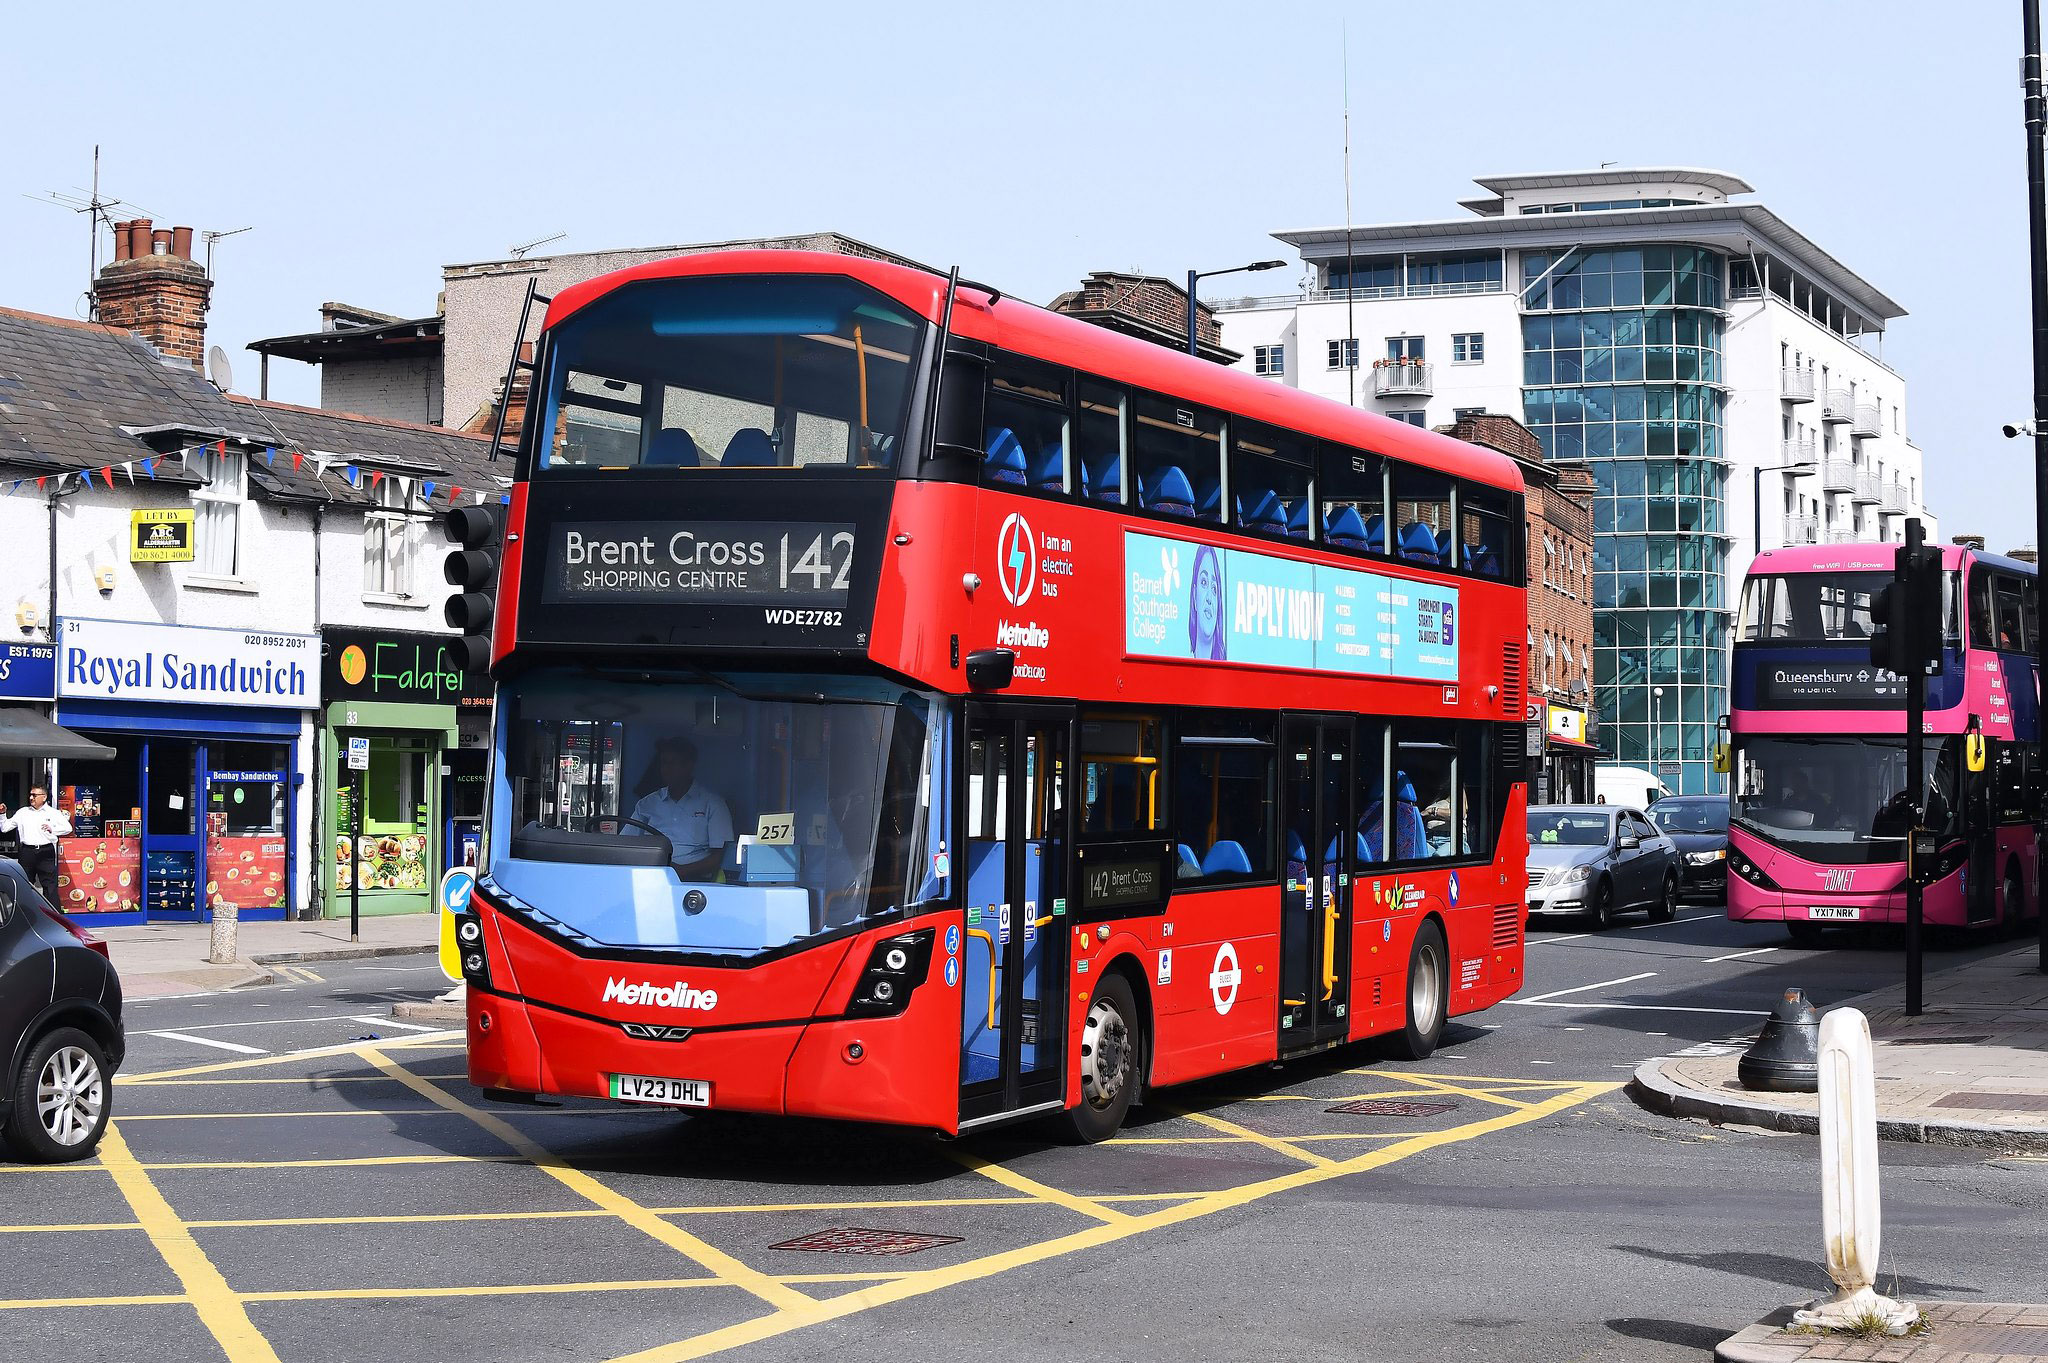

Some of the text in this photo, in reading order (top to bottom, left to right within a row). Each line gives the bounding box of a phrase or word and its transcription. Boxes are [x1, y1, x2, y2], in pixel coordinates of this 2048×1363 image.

[146, 511, 180, 520] LET BY
[150, 529, 174, 537] ABC
[1041, 531, 1072, 553] I am an
[134, 551, 191, 560] 020 8621 4000
[566, 531, 856, 590] Brent Cross 142
[1042, 556, 1073, 576] electric
[583, 571, 748, 588] SHOPPING CENTRE
[1042, 579, 1058, 597] bus
[1133, 572, 1163, 596] Barnet
[1133, 595, 1178, 621] Southgate
[1234, 580, 1325, 641] APPLY NOW
[1418, 598, 1440, 614] ENROLMENT
[765, 609, 842, 626] WDE2782
[1418, 614, 1433, 629] STARTS
[69, 622, 80, 632] 31
[996, 618, 1049, 649] Metroline
[1133, 616, 1166, 644] College
[244, 634, 307, 649] 020 8952 2031
[1425, 630, 1439, 645] AUGUST
[9, 646, 53, 659] EST. 1975
[67, 647, 305, 696] Royal Sandwich
[347, 711, 357, 724] 33
[213, 771, 279, 781] Bombay Sandwiches
[760, 824, 790, 840] 257
[1090, 868, 1152, 899] 142 Brent Cross
[1824, 868, 1857, 891] COMET
[1815, 908, 1854, 918] YX17 NRK
[1163, 922, 1174, 937] EW
[602, 975, 718, 1011] Metroline
[621, 1077, 705, 1102] LV23 DHL
